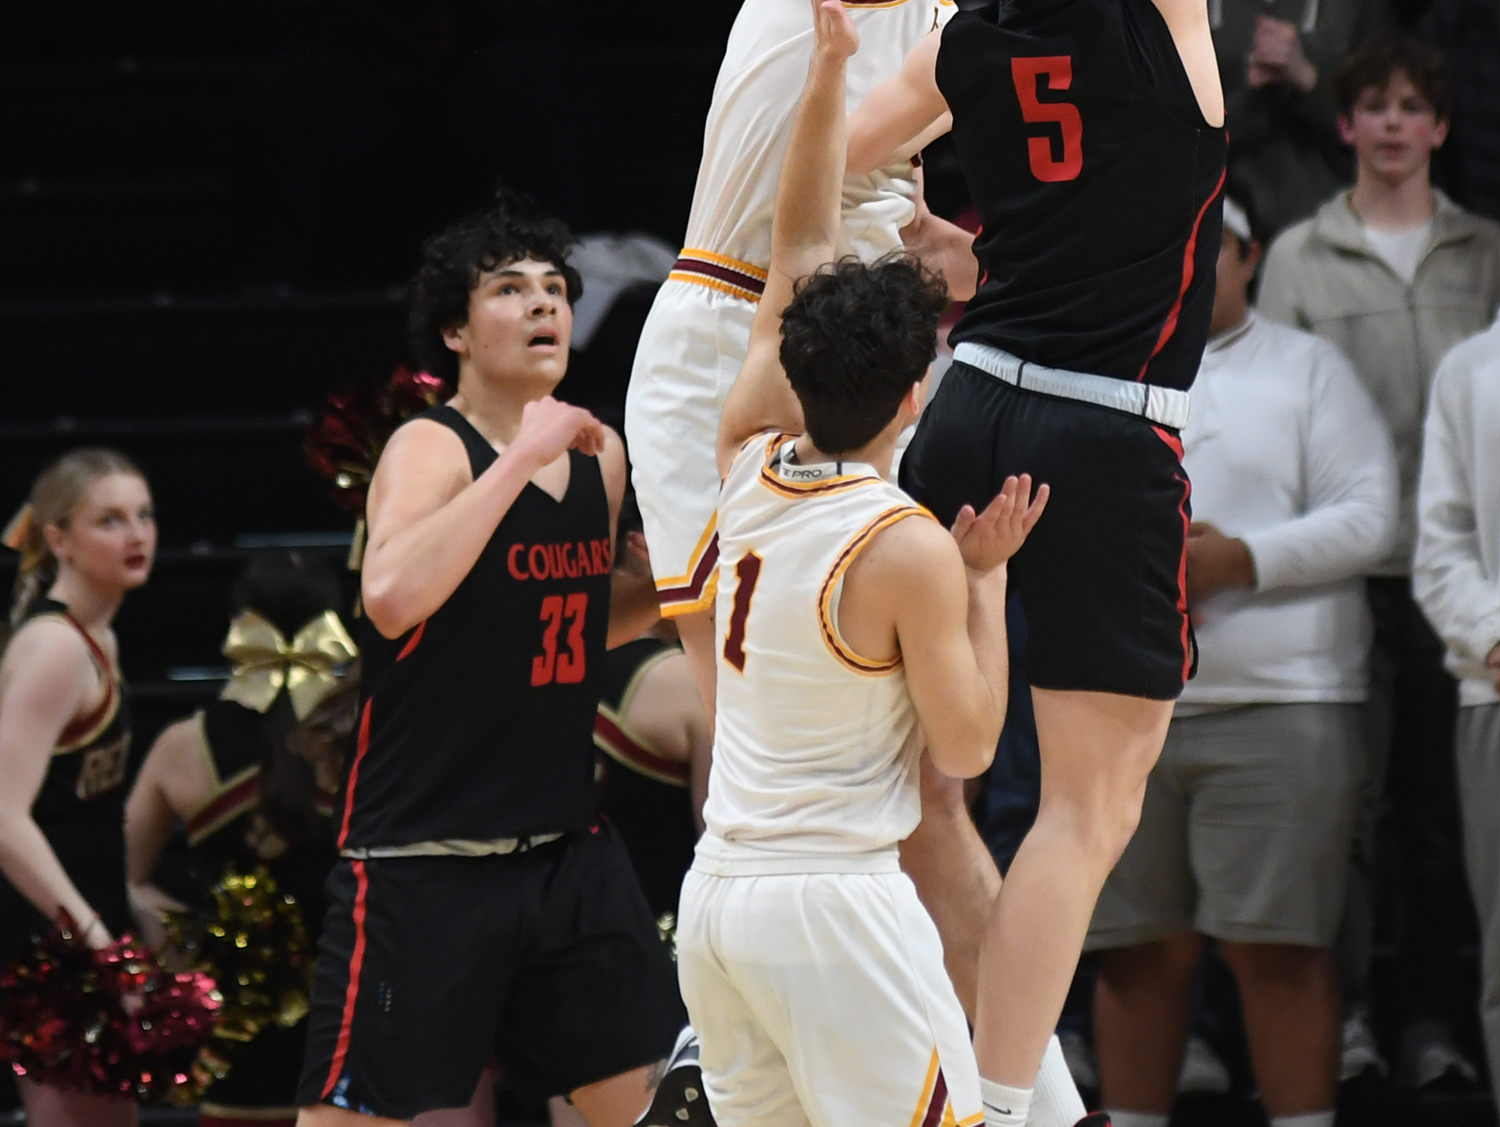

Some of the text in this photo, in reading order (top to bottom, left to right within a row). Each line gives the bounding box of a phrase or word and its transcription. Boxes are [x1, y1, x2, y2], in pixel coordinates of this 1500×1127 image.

[1011, 55, 1083, 183] 5
[792, 469, 823, 479] PRO
[507, 538, 612, 581] COUGARS
[531, 592, 588, 687] 33
[723, 549, 763, 676] 1
